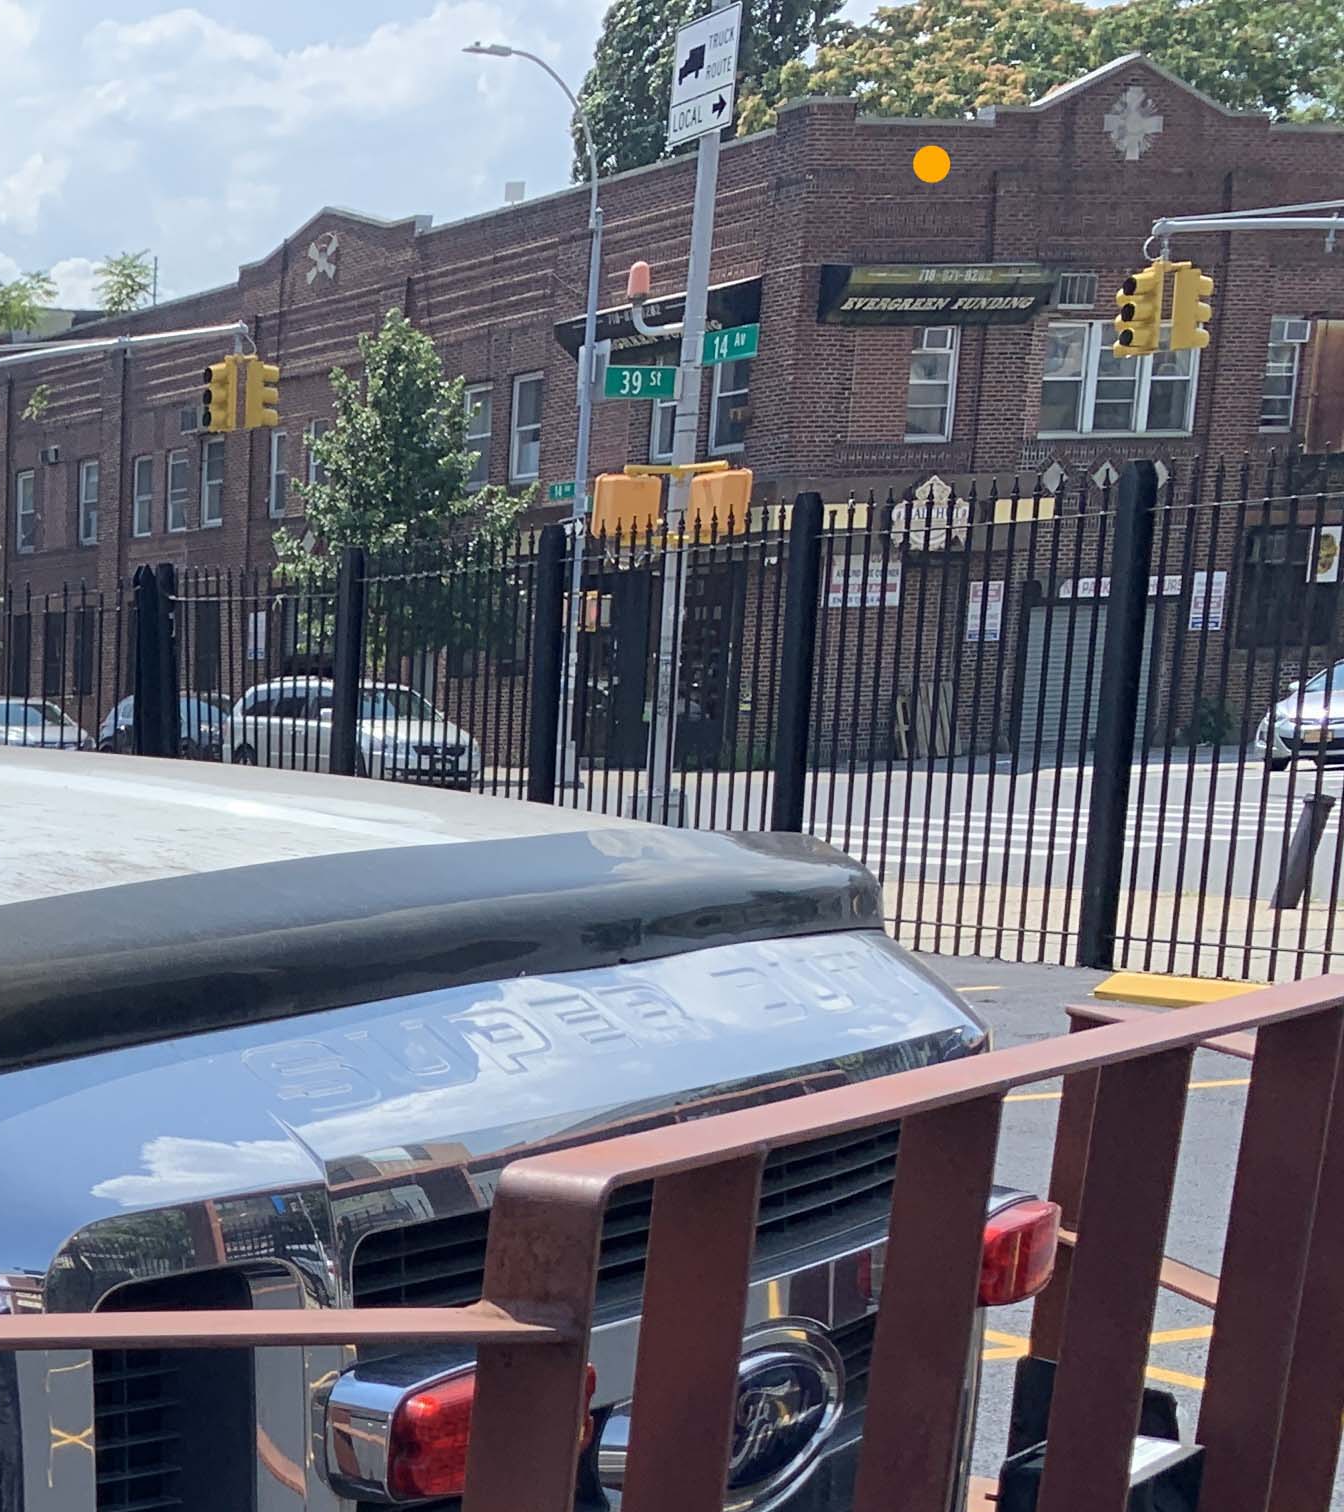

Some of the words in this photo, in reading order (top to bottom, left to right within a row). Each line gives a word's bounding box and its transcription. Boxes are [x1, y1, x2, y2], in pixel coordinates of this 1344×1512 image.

[708, 27, 735, 49] TRUCK
[705, 56, 732, 80] ROUTE
[673, 106, 702, 133] LOCAL
[839, 297, 948, 311] EVERGREEN
[950, 296, 1036, 311] FUNDING
[714, 333, 728, 360] 14
[734, 333, 746, 347] Av
[620, 371, 642, 395] 39
[649, 372, 662, 387] St
[729, 1380, 824, 1469] Ford
